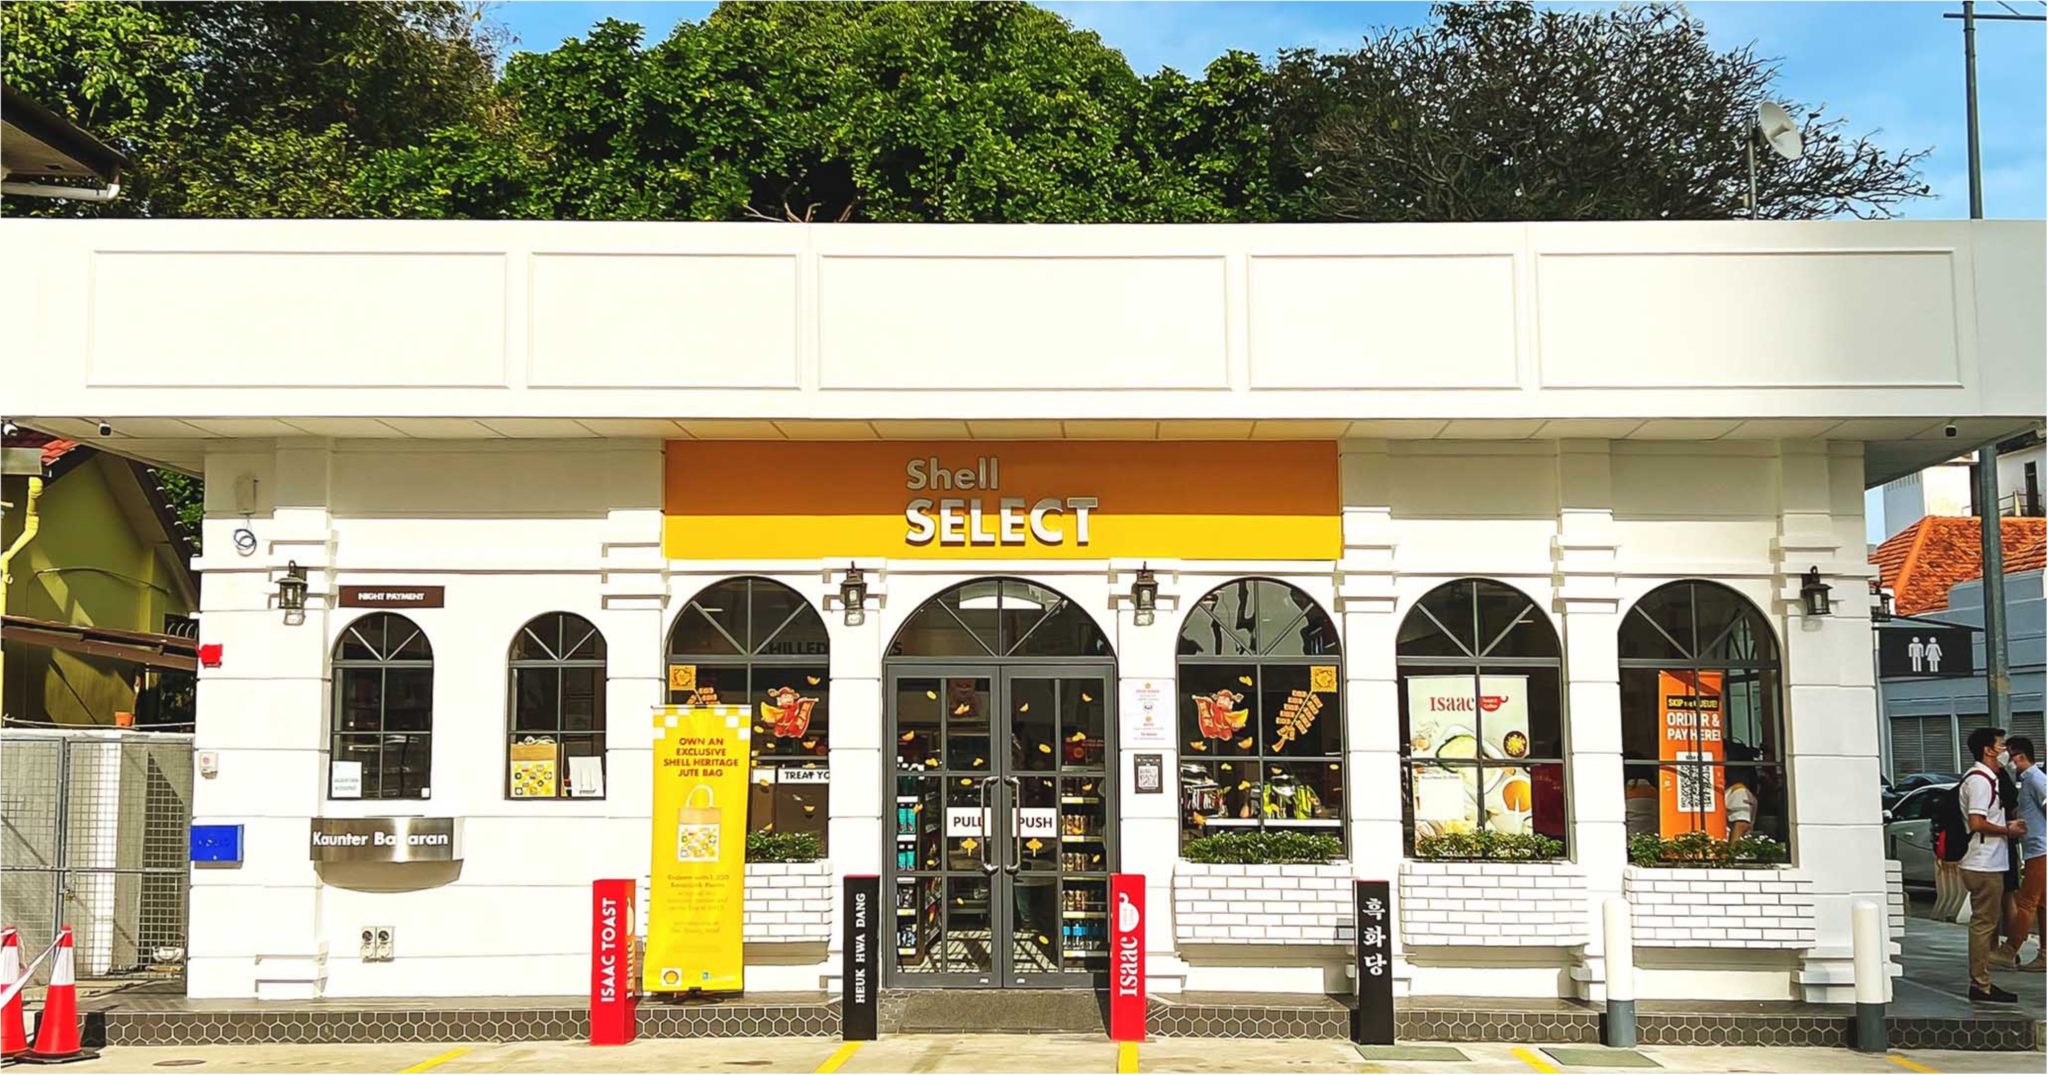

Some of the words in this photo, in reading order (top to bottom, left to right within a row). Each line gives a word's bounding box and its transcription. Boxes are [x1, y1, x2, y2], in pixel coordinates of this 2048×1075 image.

[906, 457, 999, 490] Shell
[905, 497, 1098, 545] SELECT
[1430, 697, 1474, 711] Isaac
[1668, 699, 1683, 707] SKIP
[1667, 728, 1689, 740] PAY
[1712, 713, 1720, 727] &
[676, 748, 726, 756] EXCLUSIVE
[678, 769, 699, 777] JUTE
[785, 771, 814, 779] TREAT
[313, 831, 369, 845] Kaunter
[374, 831, 448, 845] Baaran
[602, 897, 616, 950] TOAST
[855, 893, 866, 928] DANG
[855, 934, 866, 962] HWA
[1362, 898, 1387, 976] 흑화당
[601, 954, 615, 1002] ISAAC
[1120, 936, 1138, 997] Isaac
[855, 968, 866, 1003] HEUK
